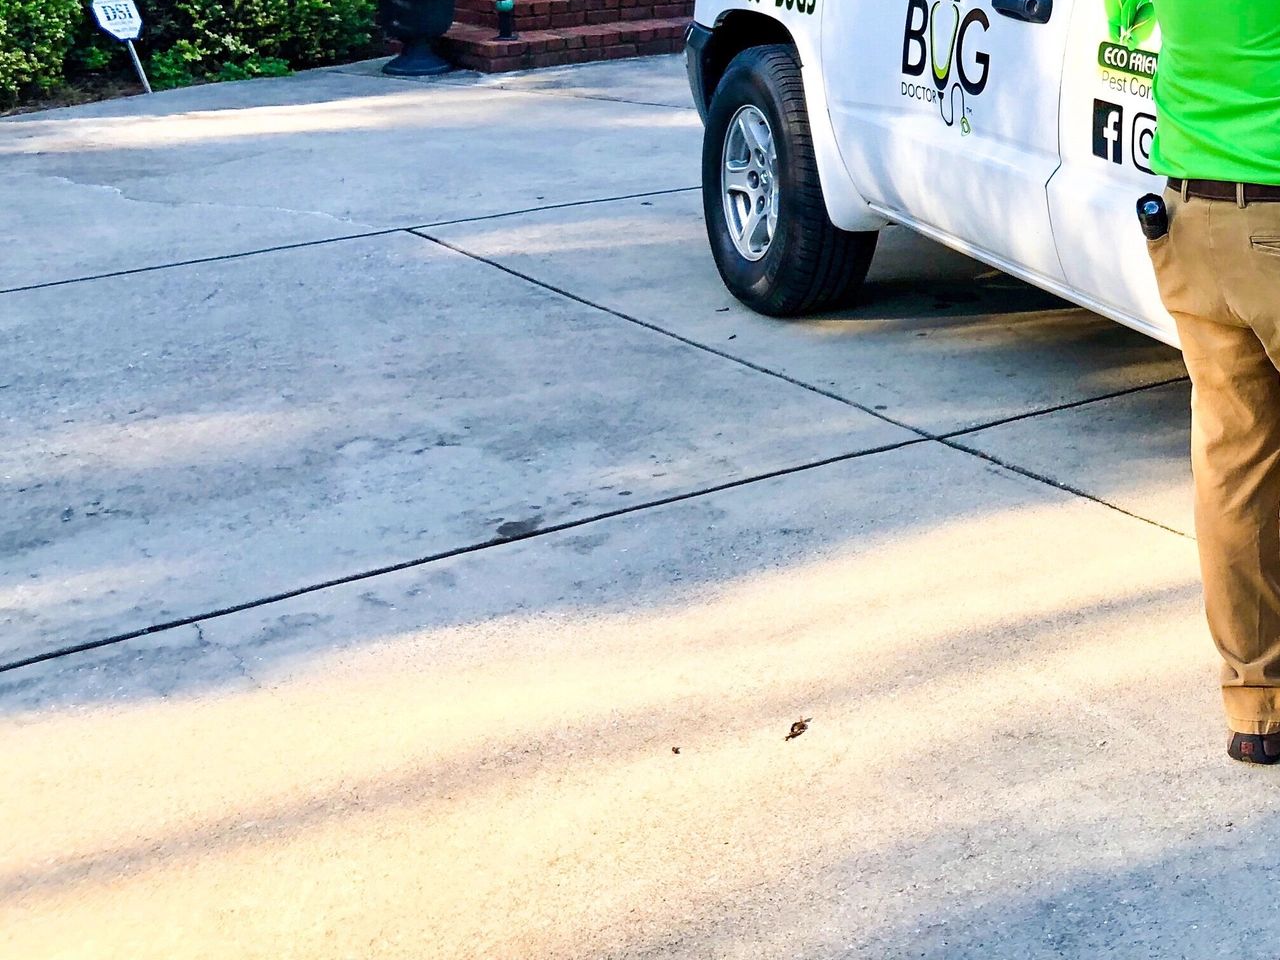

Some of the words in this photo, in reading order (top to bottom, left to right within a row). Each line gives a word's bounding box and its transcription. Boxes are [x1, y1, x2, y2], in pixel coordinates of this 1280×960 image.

[101, 4, 133, 21] DSI
[1104, 46, 1128, 68] ECO
[1129, 51, 1158, 76] FRIEN
[901, 81, 937, 104] DOCTOR
[1102, 70, 1127, 94] Pest
